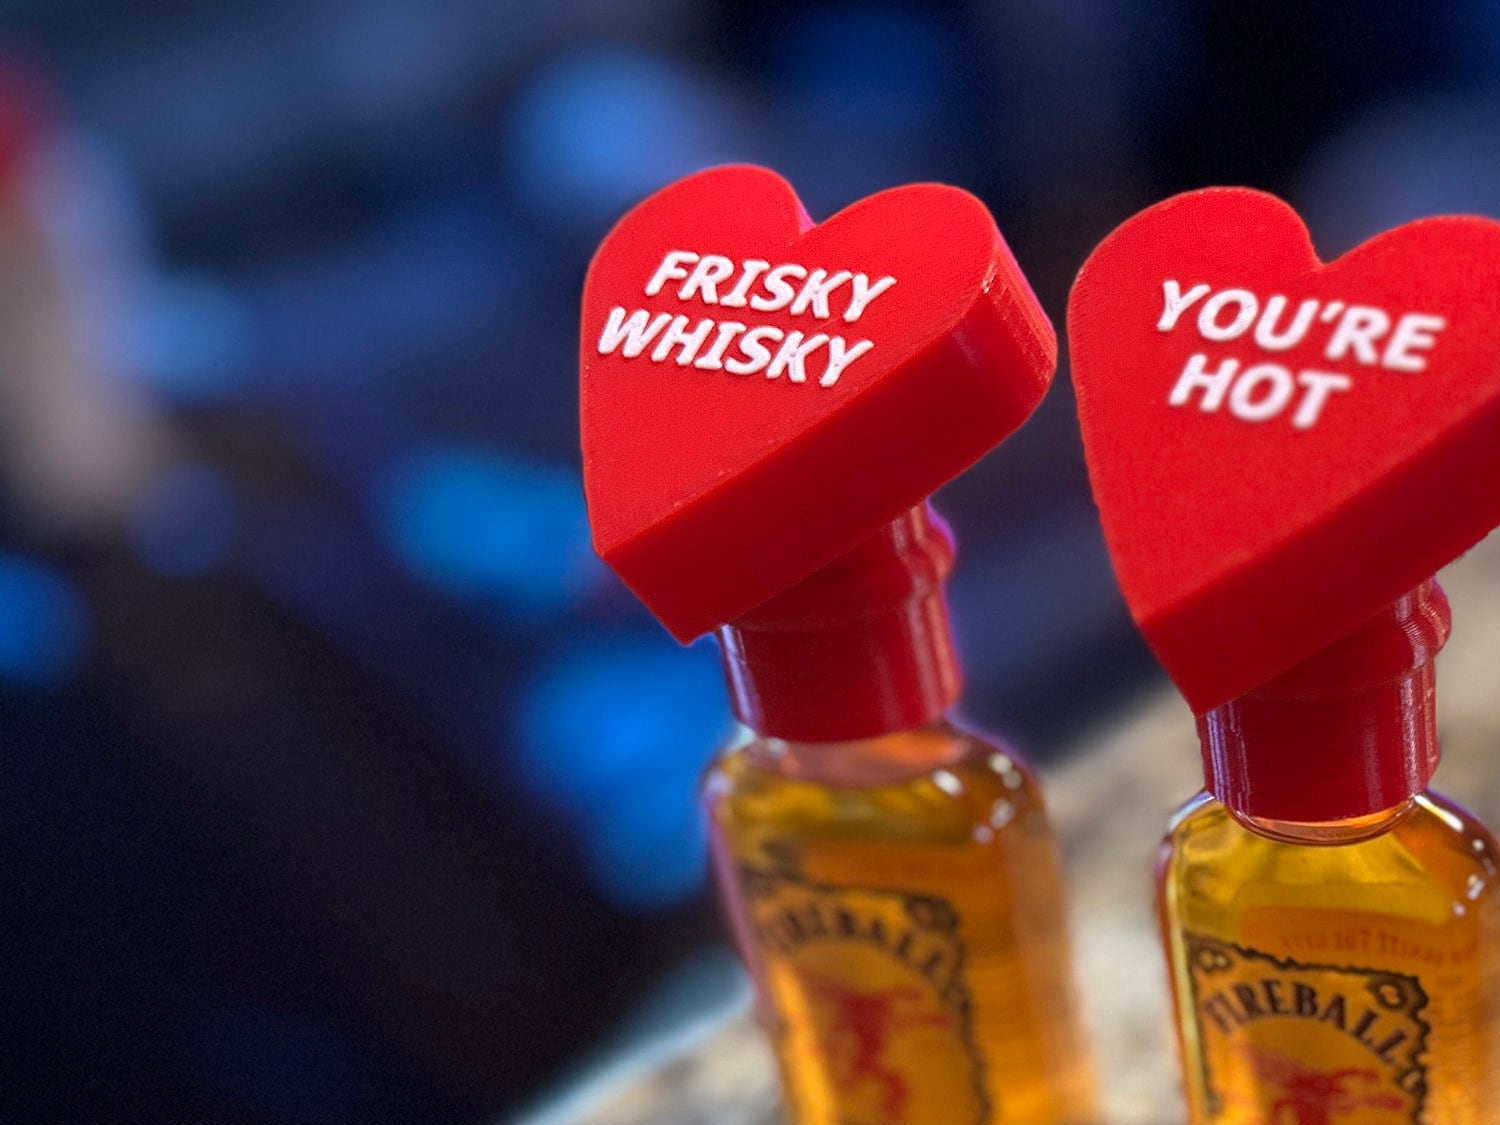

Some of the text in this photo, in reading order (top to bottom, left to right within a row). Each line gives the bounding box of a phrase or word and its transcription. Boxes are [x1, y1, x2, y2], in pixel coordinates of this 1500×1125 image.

[644, 250, 897, 323] FRISKY
[1156, 279, 1447, 373] YOU'RE
[597, 306, 874, 388] WHISKY
[1168, 353, 1352, 430] HOT
[1202, 978, 1408, 1065] FIREBALL
